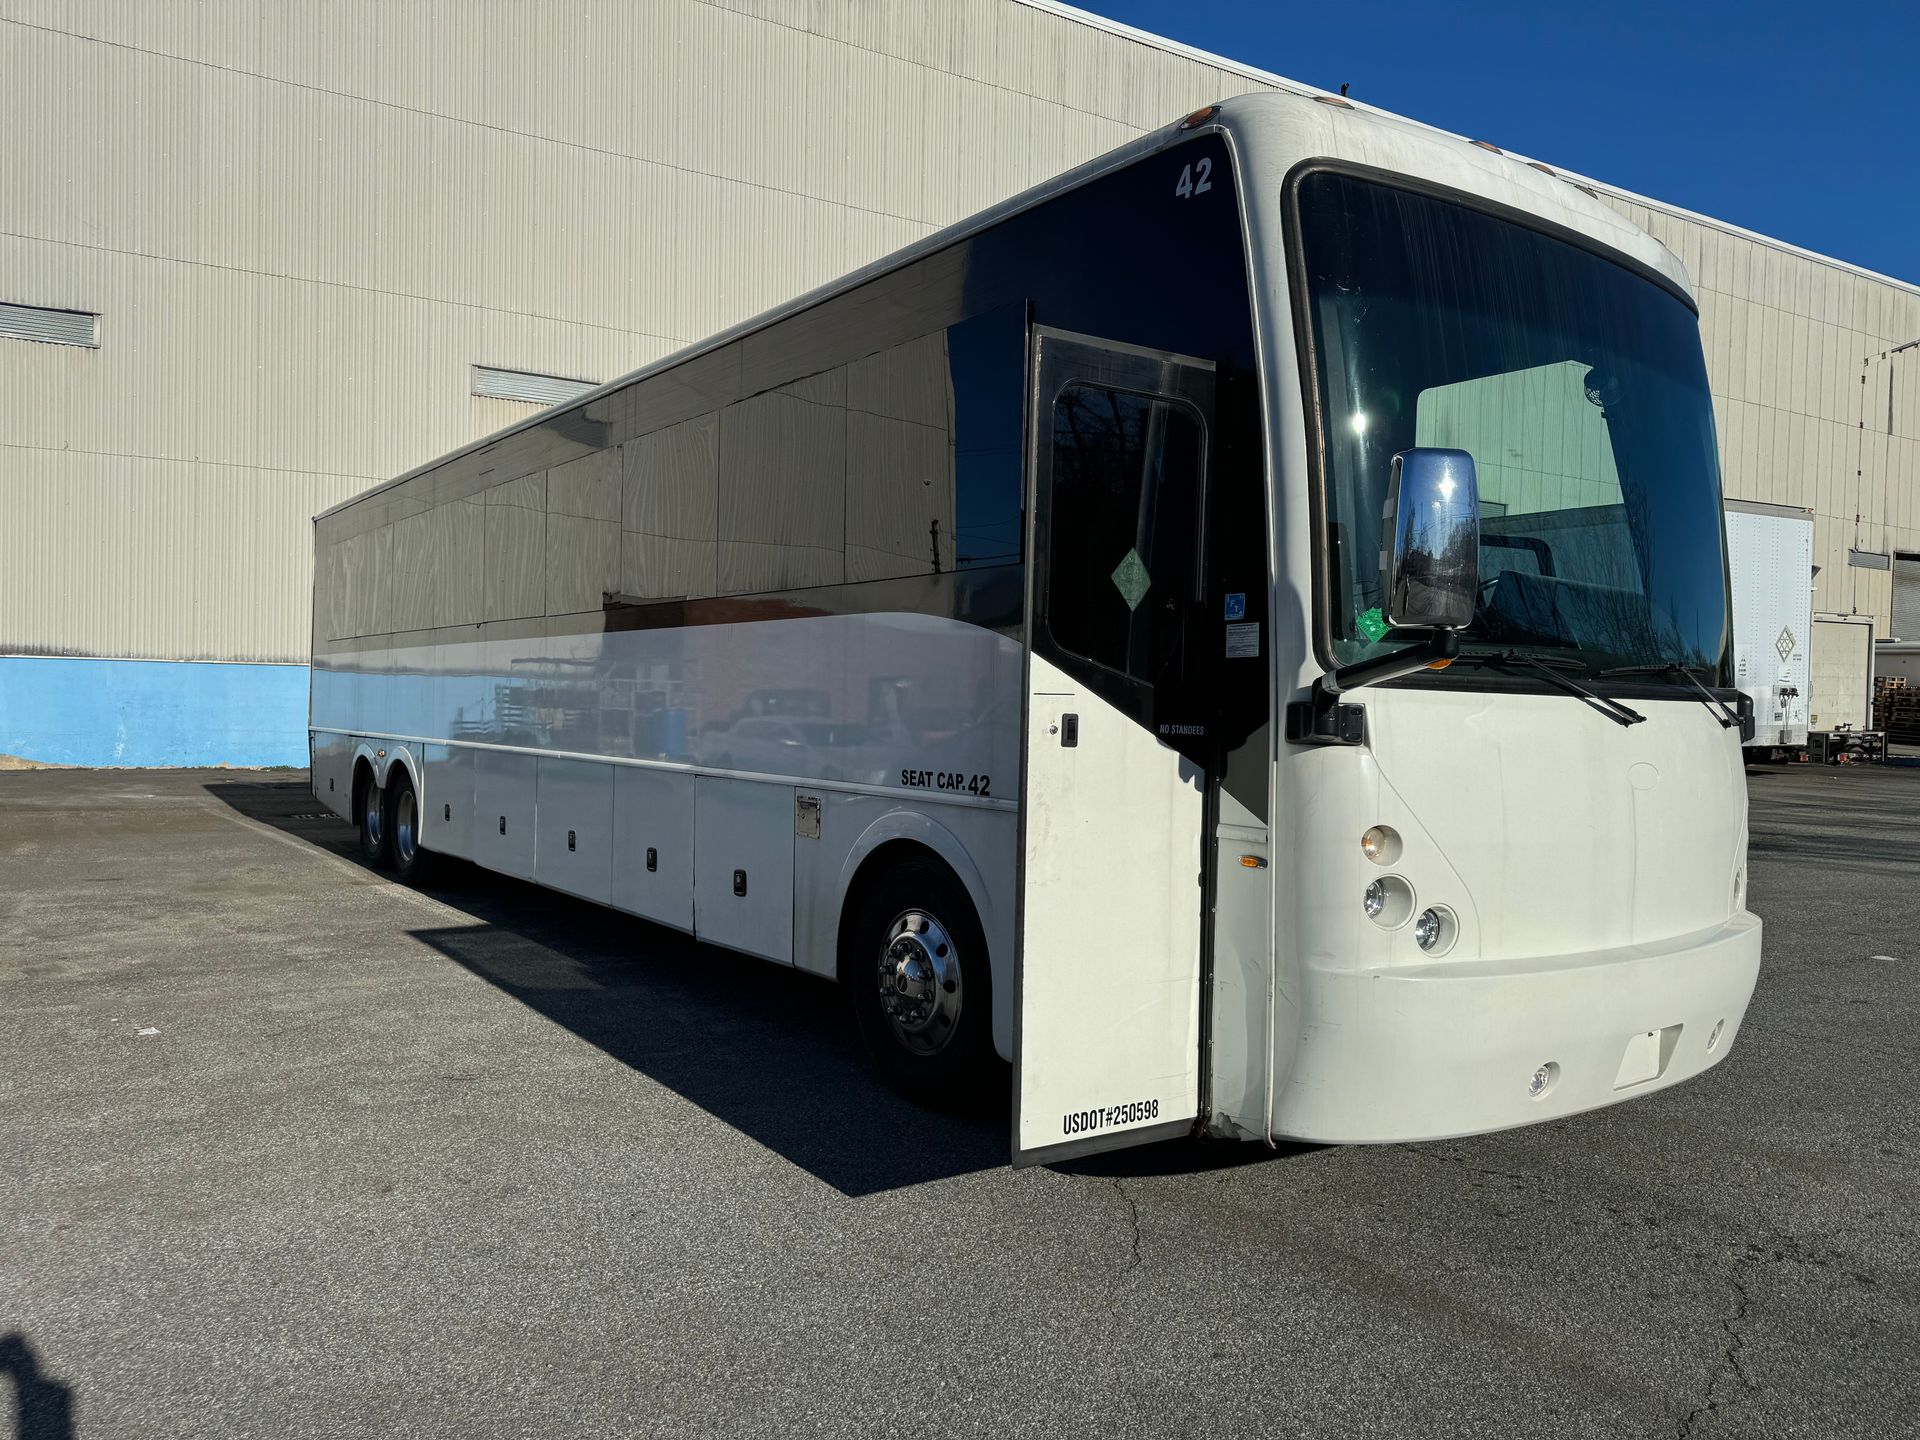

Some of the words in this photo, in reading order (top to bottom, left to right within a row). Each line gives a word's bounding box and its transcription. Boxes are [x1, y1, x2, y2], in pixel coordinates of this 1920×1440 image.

[1175, 156, 1213, 199] 42
[1159, 724, 1170, 734] NO
[1171, 724, 1204, 735] STANDEES
[901, 769, 933, 787] SEAT
[937, 772, 966, 790] CAP.
[968, 774, 991, 796] 42
[1063, 1099, 1159, 1135] USDOT#250598
